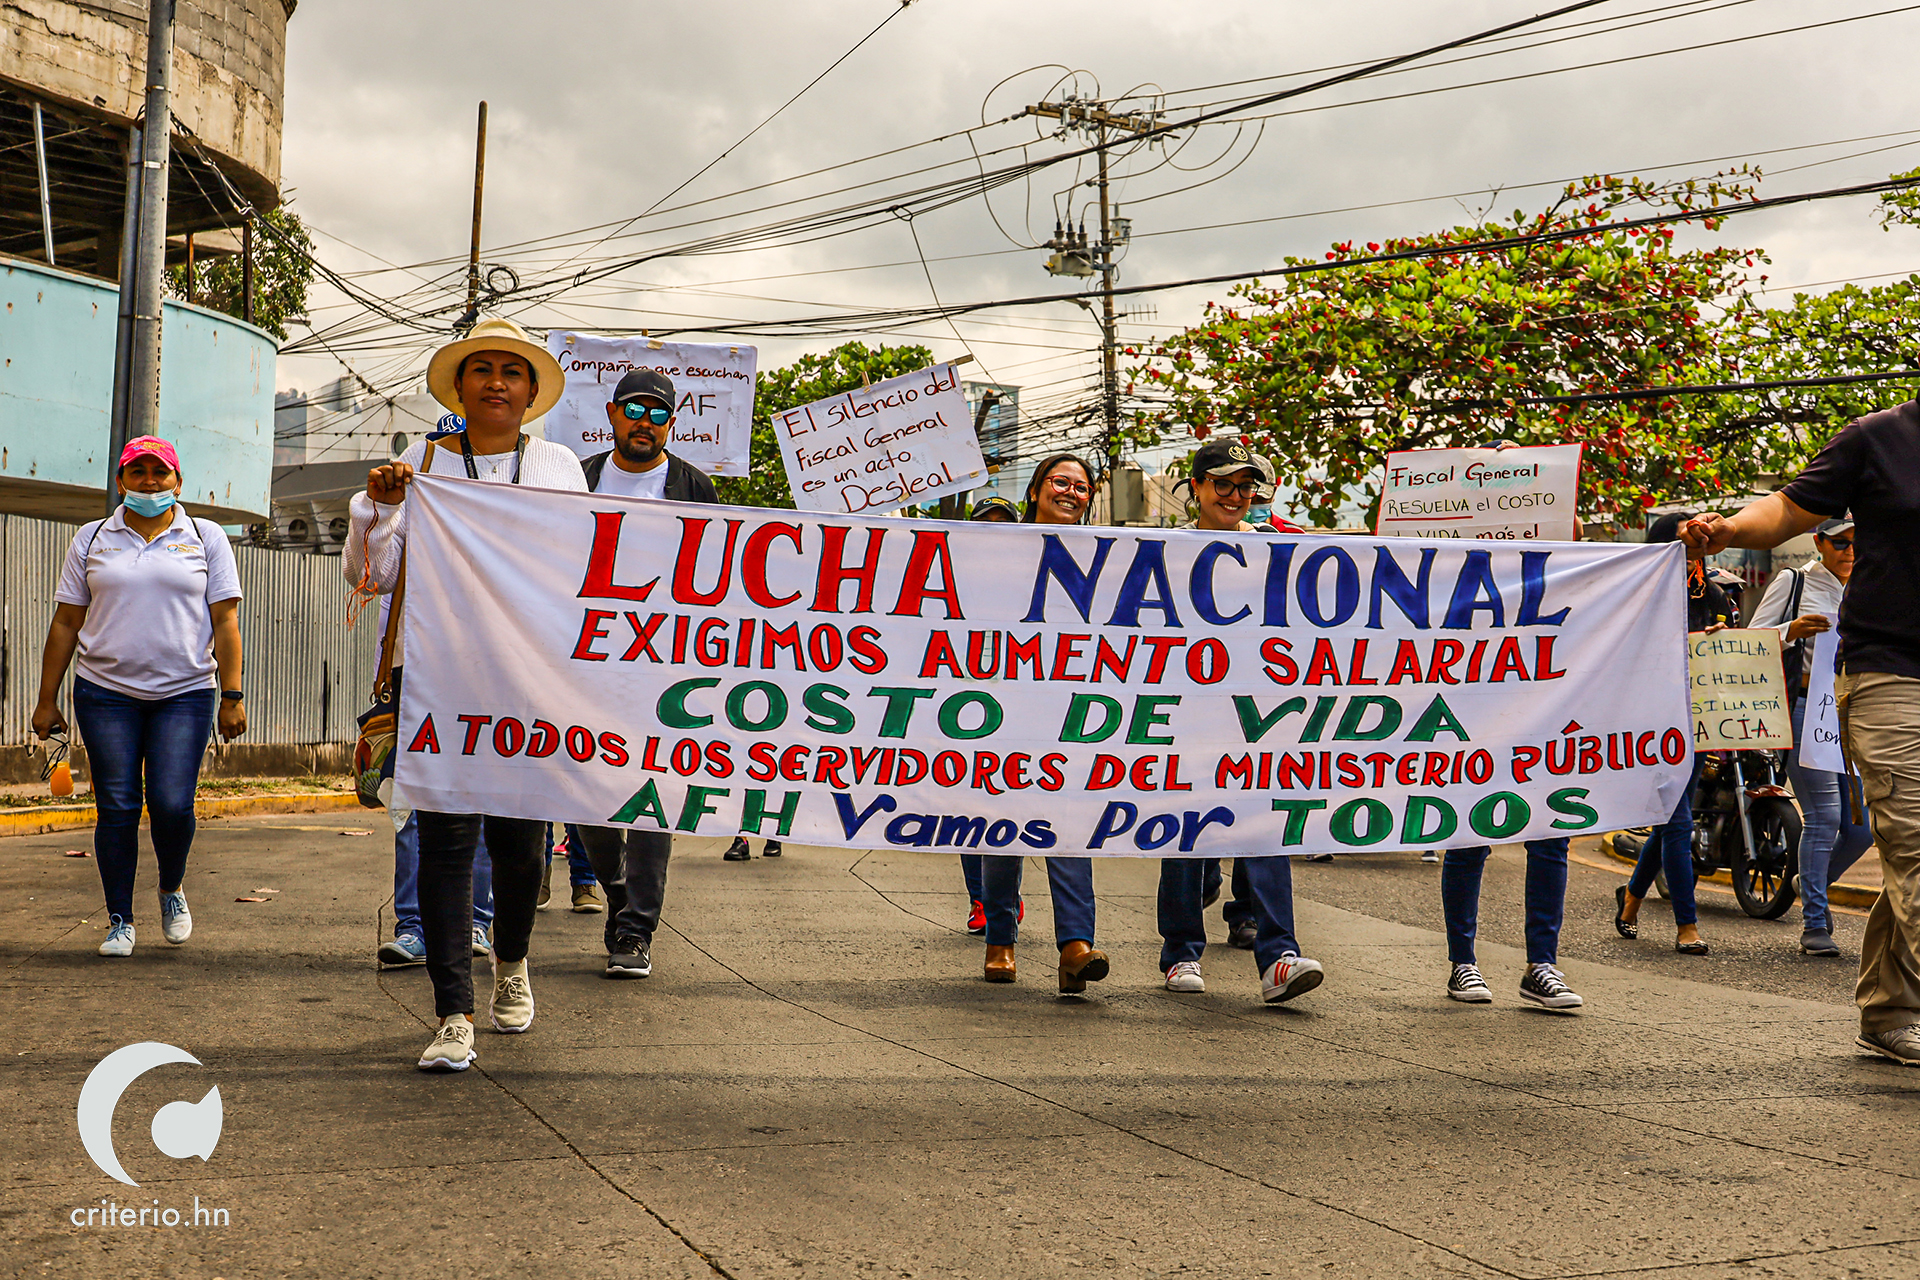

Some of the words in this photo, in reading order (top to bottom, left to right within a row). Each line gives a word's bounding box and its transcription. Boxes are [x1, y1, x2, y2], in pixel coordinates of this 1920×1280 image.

[685, 365, 750, 384] escuchan
[782, 407, 817, 438] El
[923, 367, 956, 396] del
[671, 423, 721, 446] lucha!
[863, 411, 948, 447] General
[801, 479, 826, 493] es
[833, 468, 857, 483] un
[864, 449, 911, 473] acto
[840, 461, 953, 513] Desleal
[1390, 465, 1454, 487] Fiscal
[1465, 462, 1539, 488] General
[1383, 498, 1470, 517] RESUELVA
[1476, 497, 1490, 512] el
[1497, 492, 1555, 510] COSTO
[1475, 526, 1516, 540] más
[1523, 523, 1539, 539] el
[576, 510, 965, 620] LUCHA
[1019, 533, 1573, 630] NACIONAL
[570, 608, 889, 675] EXIGIMOS
[918, 628, 1231, 685] AUMENTO
[1259, 634, 1567, 687] SALARIAL
[655, 676, 1005, 740] COSTO
[1058, 692, 1183, 746] DE
[1231, 692, 1471, 744] VIDA
[1752, 695, 1781, 712] ESTÁ
[407, 711, 442, 754] A
[456, 713, 630, 768] TODOS
[640, 734, 736, 779] LOS
[745, 740, 1070, 795] SERVIDORES
[1084, 753, 1193, 793] DEL
[1214, 748, 1495, 790] MINISTERIO
[1511, 719, 1687, 784] PÚBLICO
[607, 777, 803, 837] AFH
[828, 791, 1058, 851] Vamos
[1086, 800, 1236, 852] Por
[1271, 787, 1600, 847] TODOS
